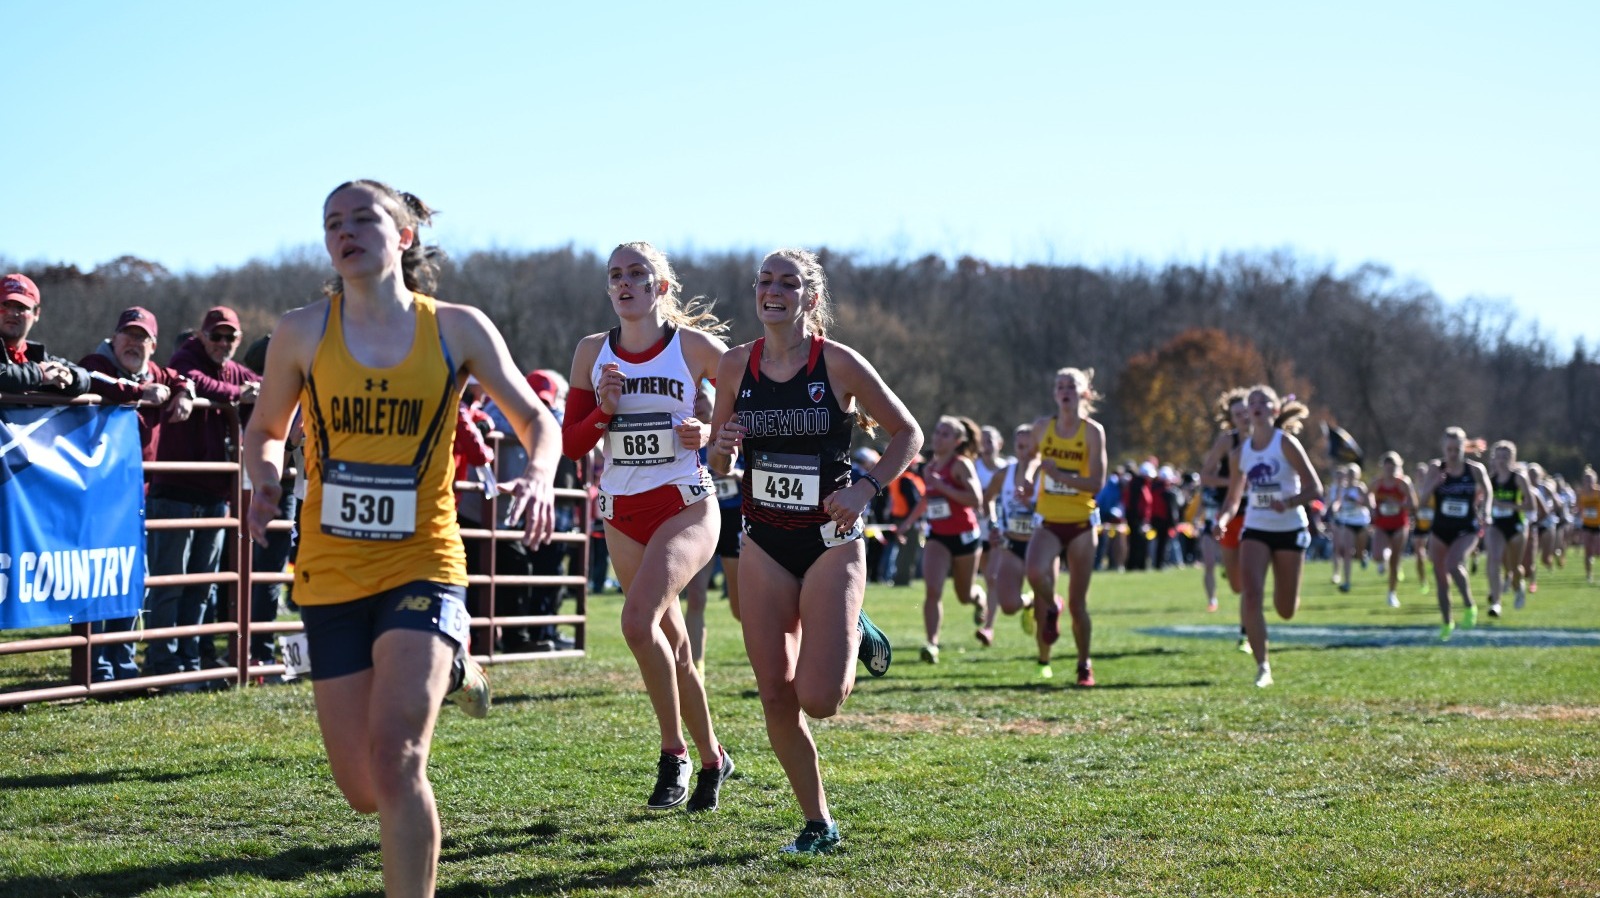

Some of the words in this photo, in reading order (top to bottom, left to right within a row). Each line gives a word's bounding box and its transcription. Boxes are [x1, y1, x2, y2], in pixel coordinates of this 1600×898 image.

[620, 376, 684, 403] AWRENCE
[331, 396, 423, 436] CARLETON
[623, 433, 660, 456] 683
[1043, 446, 1084, 461] CALVIN
[765, 475, 804, 501] 434
[340, 492, 395, 526] 530
[19, 546, 136, 604] COUNTRY
